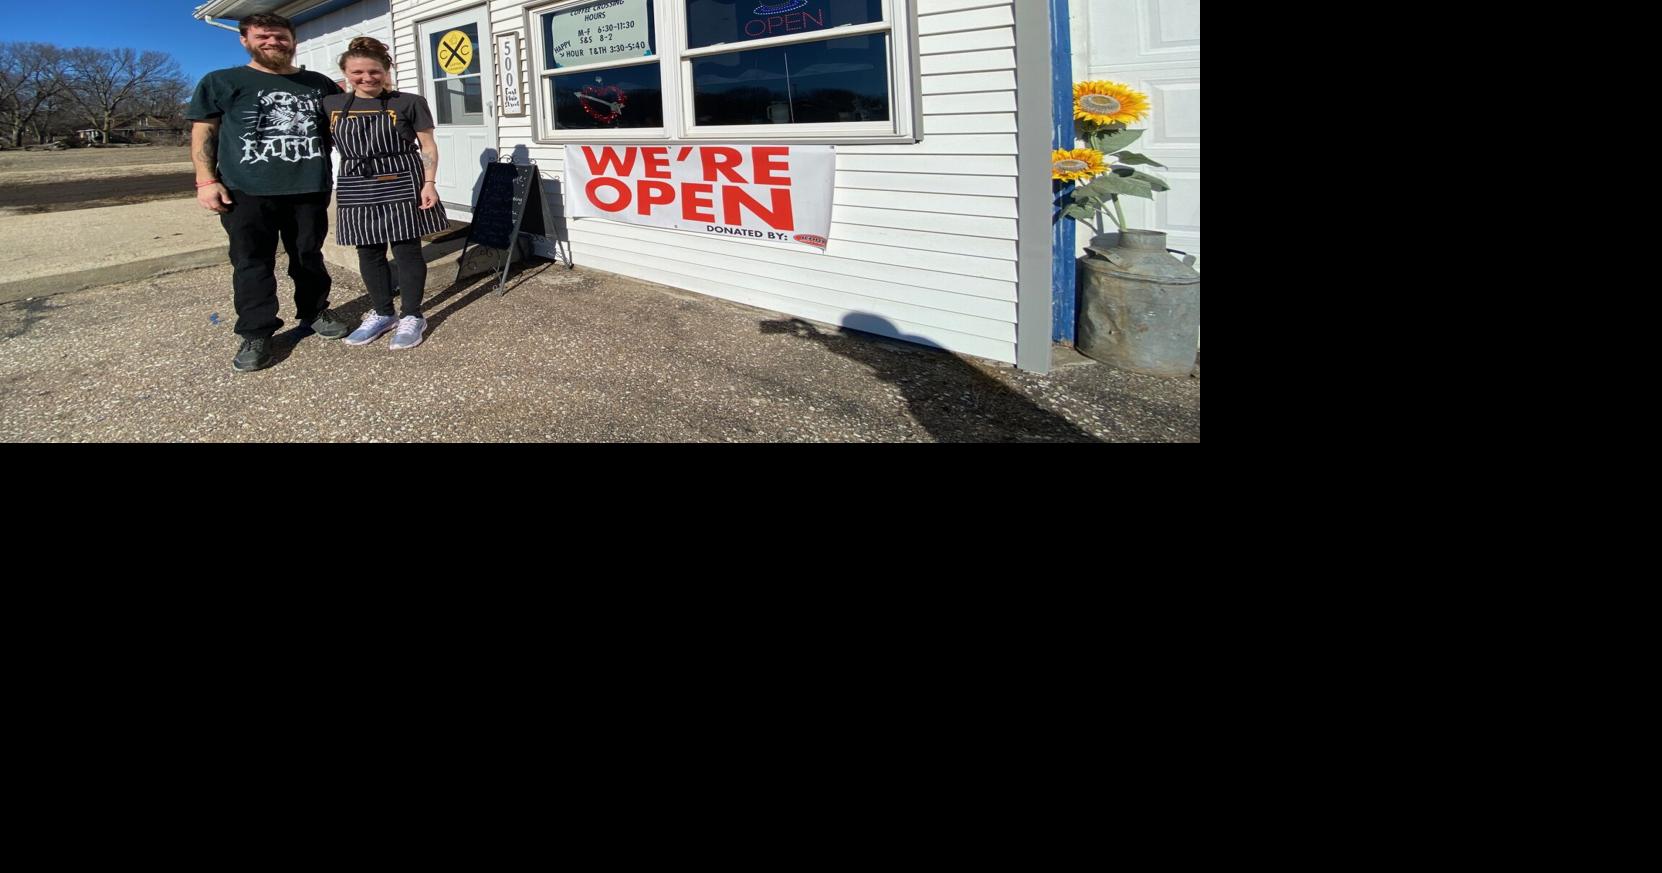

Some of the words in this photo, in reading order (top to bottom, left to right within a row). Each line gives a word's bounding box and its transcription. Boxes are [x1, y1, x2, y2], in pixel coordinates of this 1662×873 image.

[584, 12, 606, 22] HOURS
[744, 8, 824, 36] OPEN
[577, 28, 591, 37] M-F
[597, 20, 635, 34] 6:30-11:30
[553, 40, 572, 54] HAPPY
[579, 36, 593, 44] S&S
[599, 33, 613, 42] 8-2
[566, 49, 584, 58] HOUR
[589, 46, 607, 56] T&TH
[609, 41, 646, 53] 3:30-5:40
[580, 145, 792, 187] WE'RE
[584, 176, 795, 231] OPEN
[706, 224, 764, 238] DONATED
[767, 231, 789, 241] BY:
